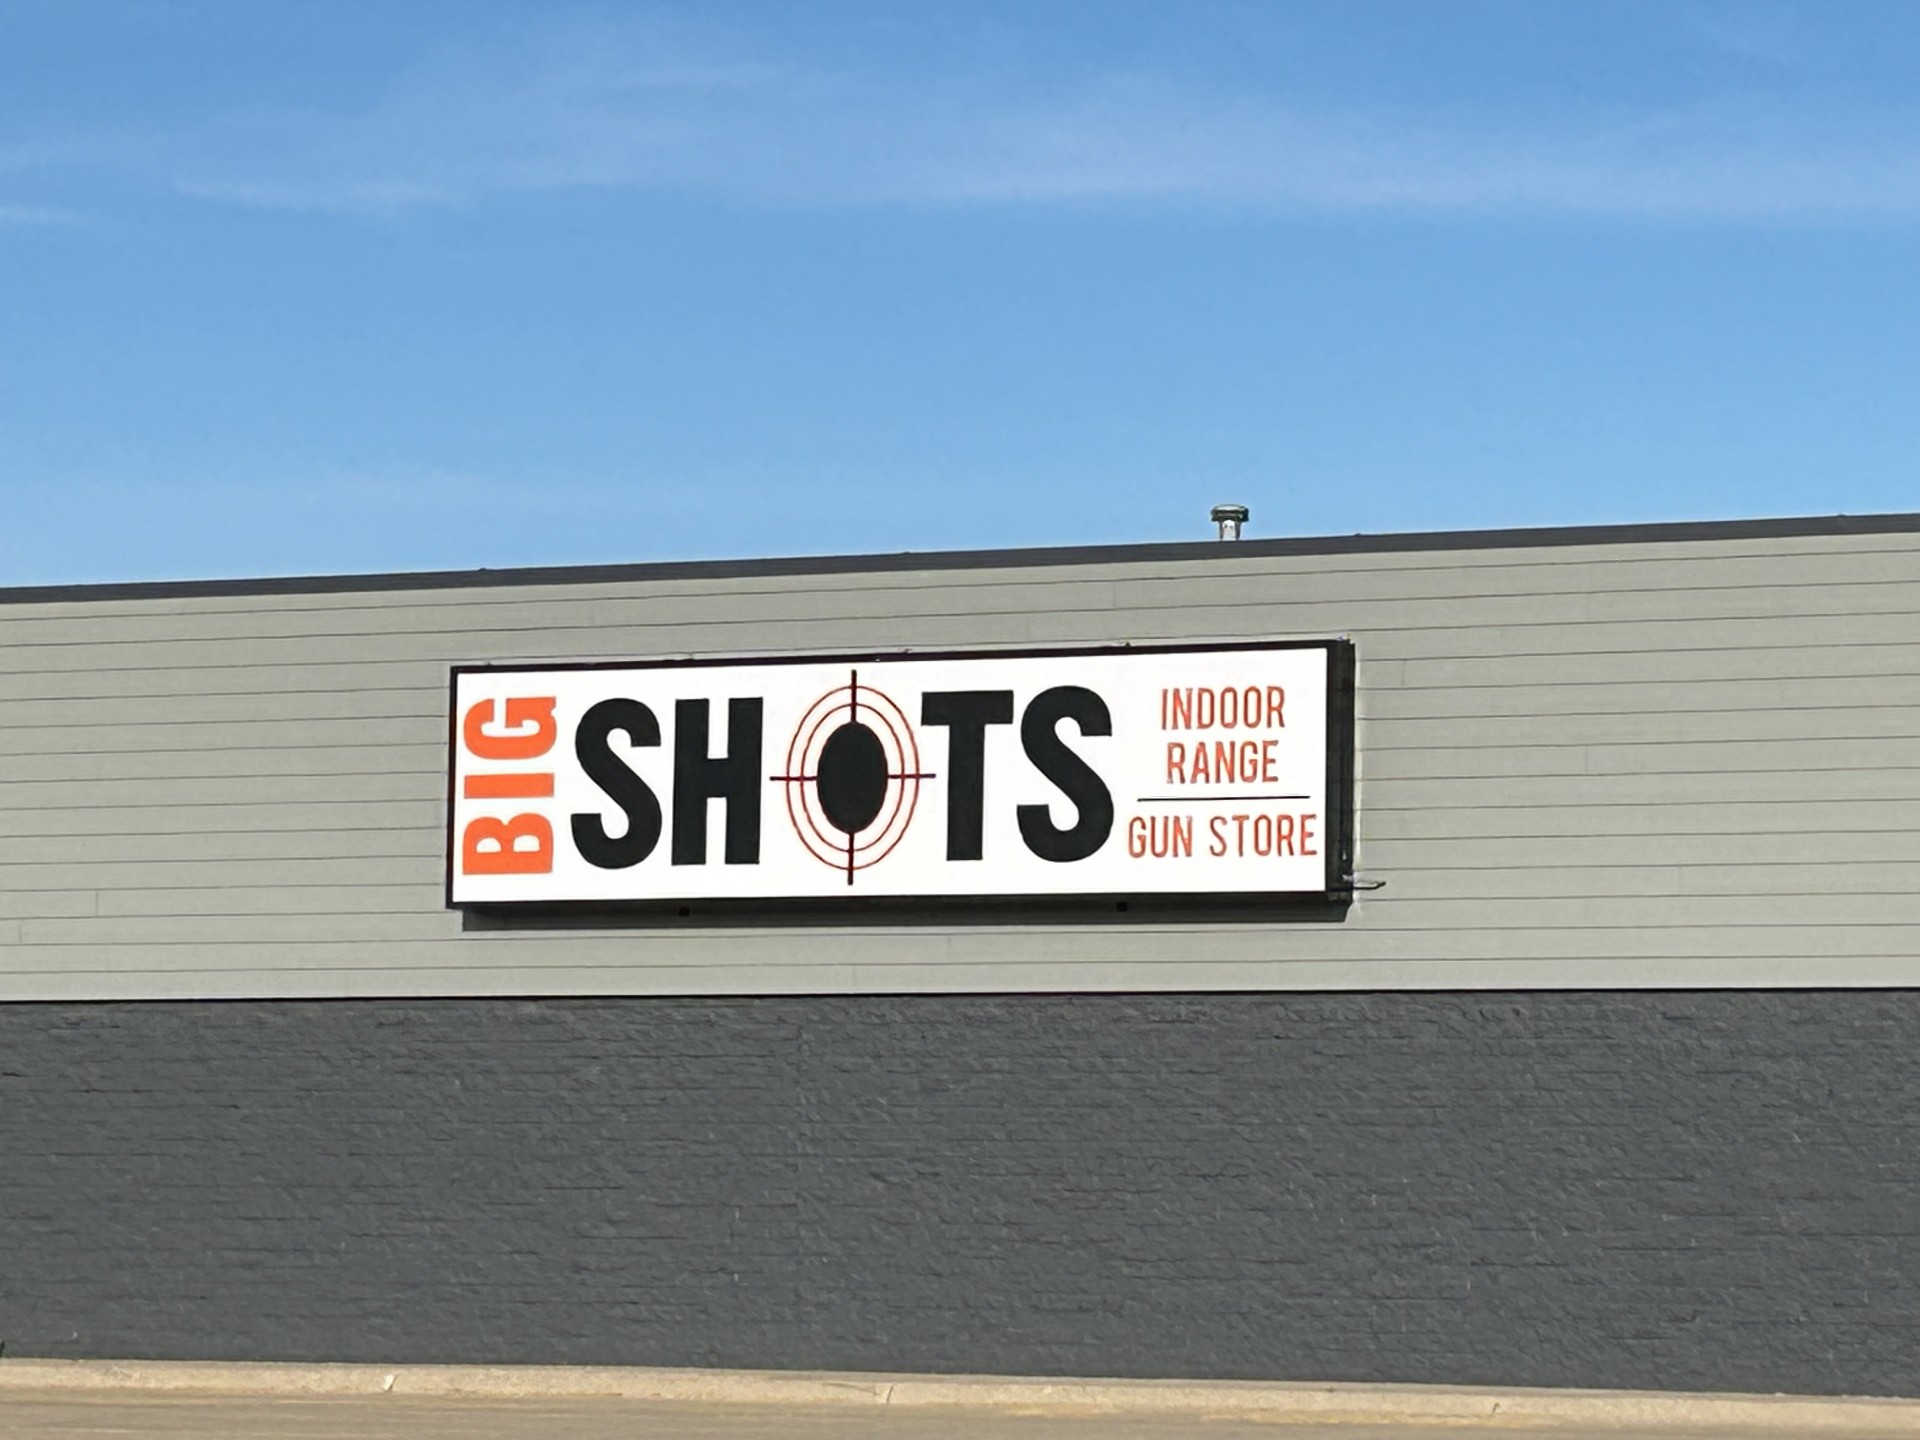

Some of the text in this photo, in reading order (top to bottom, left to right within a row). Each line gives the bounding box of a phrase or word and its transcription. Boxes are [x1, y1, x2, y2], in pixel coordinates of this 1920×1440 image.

[1161, 686, 1286, 730] INDOOR
[571, 685, 1114, 870] SHOTS
[1166, 740, 1279, 784] RANGE
[463, 696, 557, 875] BIG
[1128, 814, 1318, 858] GUN STORE
